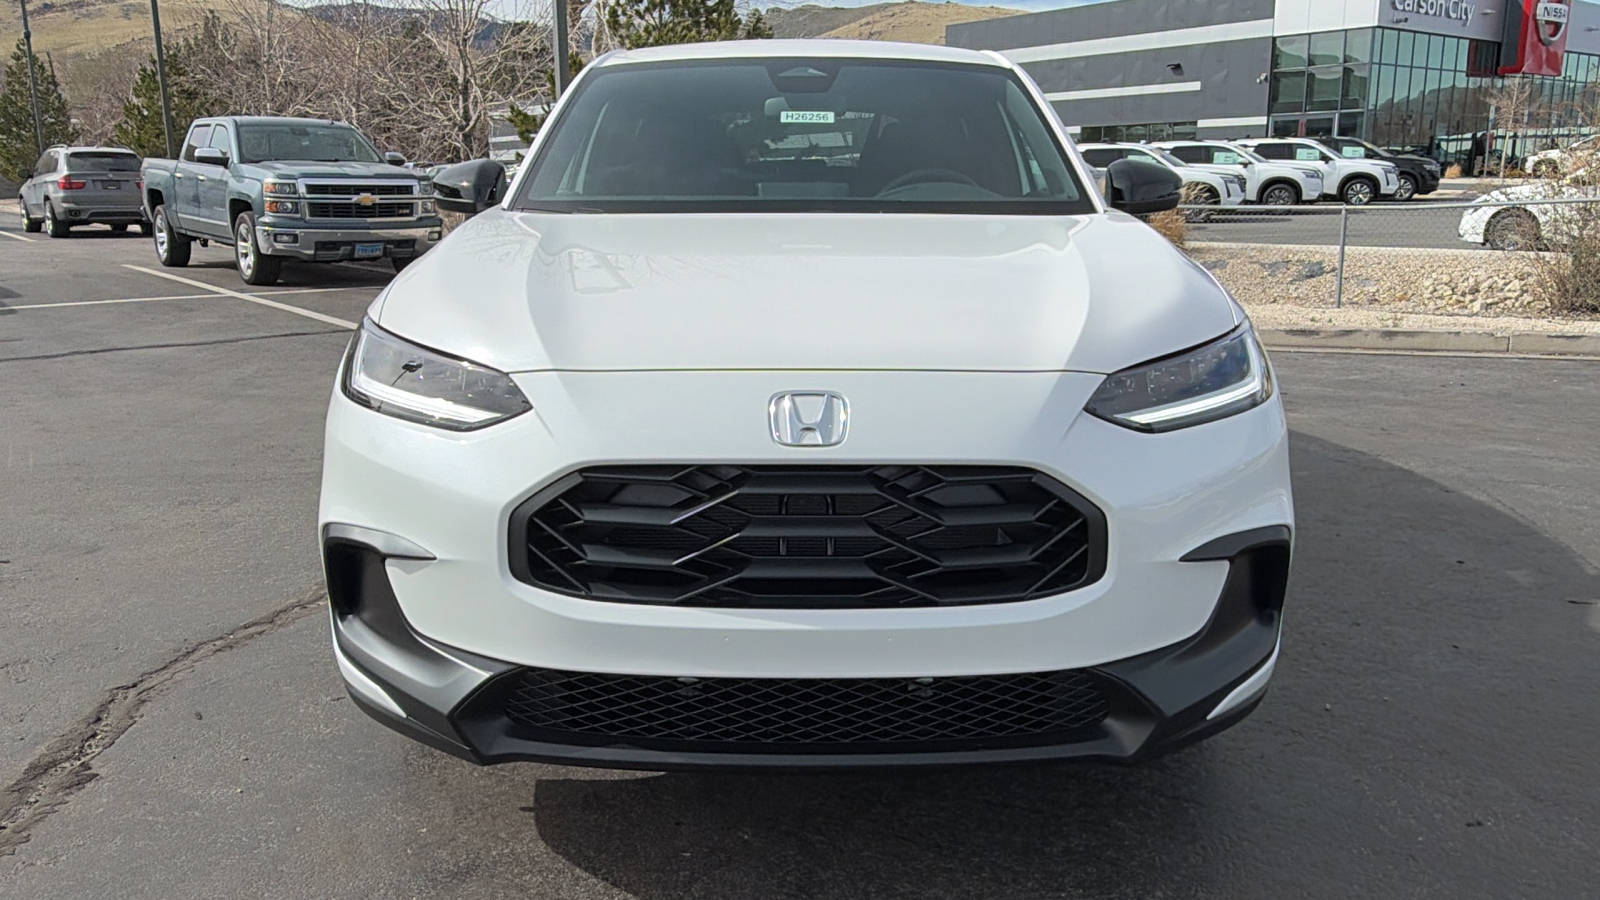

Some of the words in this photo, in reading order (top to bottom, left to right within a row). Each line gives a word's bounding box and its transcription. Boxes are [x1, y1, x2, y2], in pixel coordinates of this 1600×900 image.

[1394, 0, 1446, 17] Carson
[1448, 0, 1476, 26] City
[1542, 6, 1566, 18] NISSA
[785, 112, 829, 121] H26256
